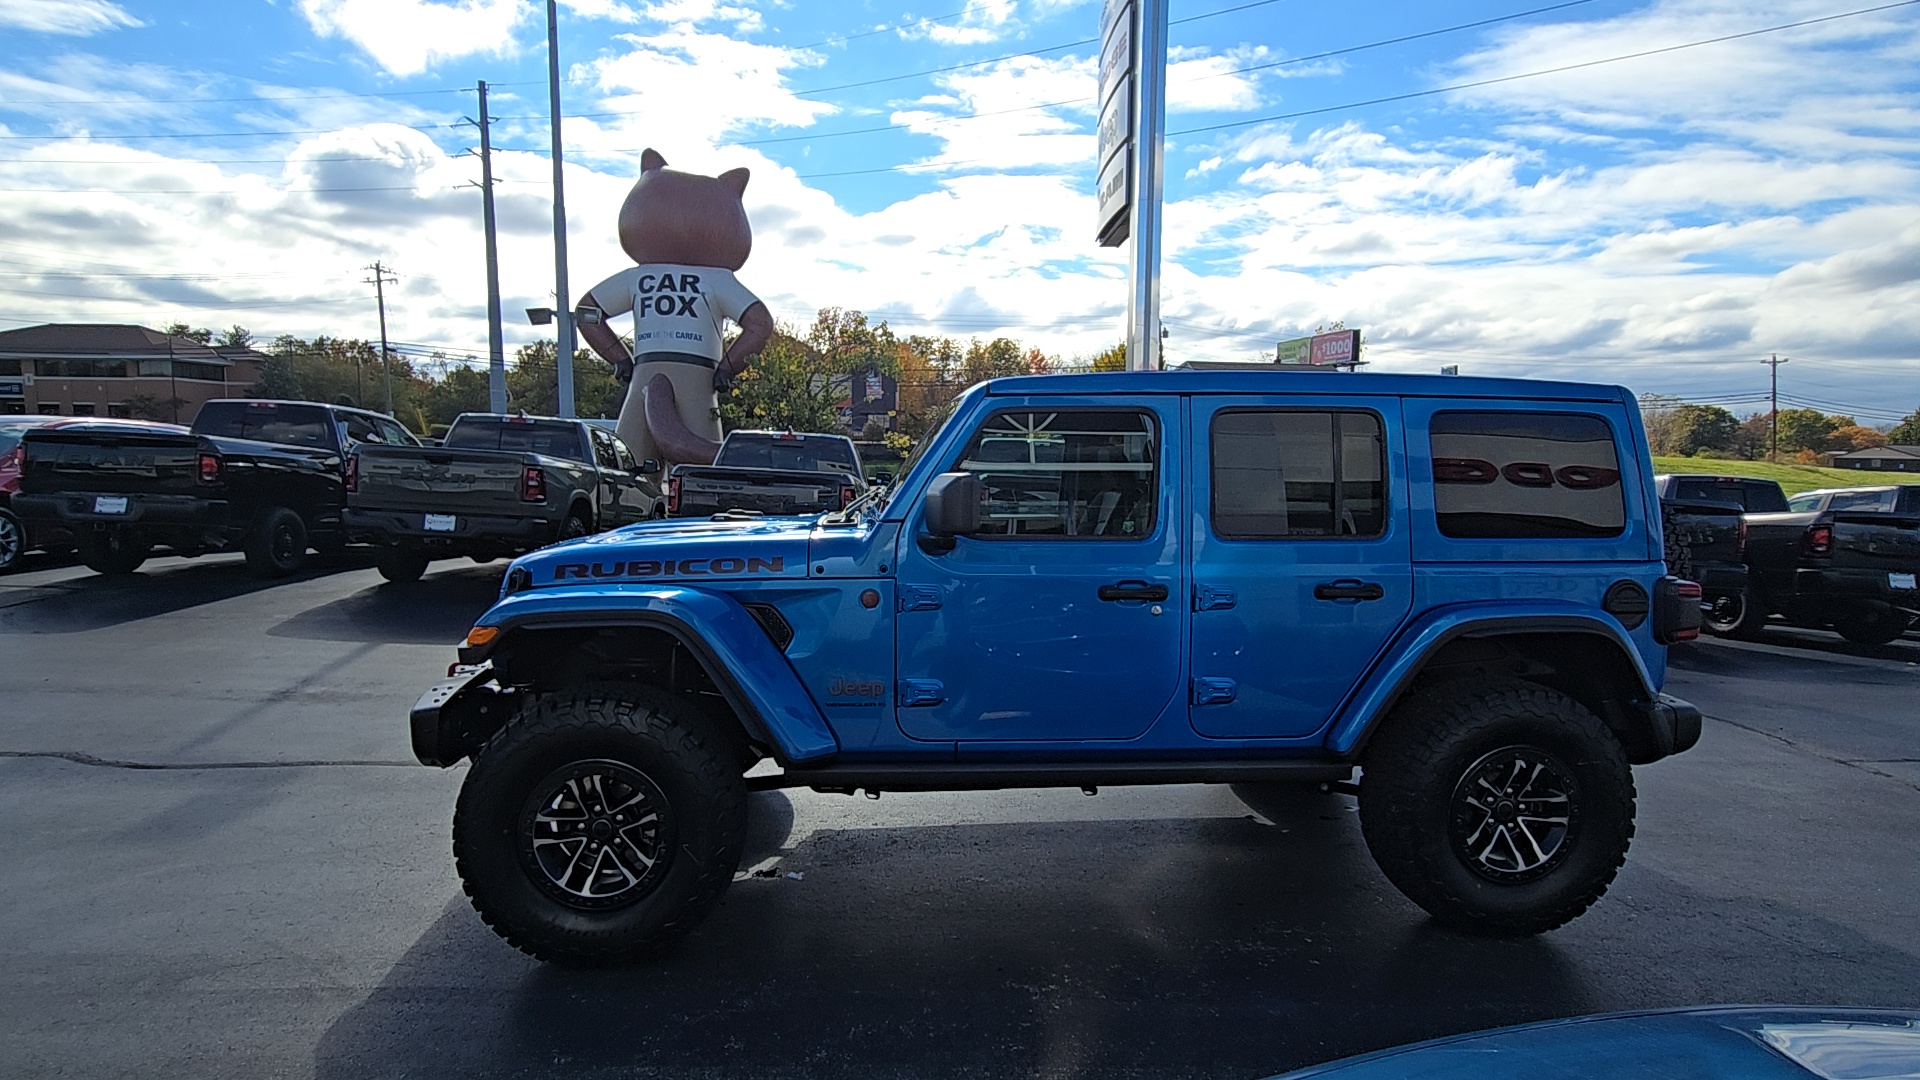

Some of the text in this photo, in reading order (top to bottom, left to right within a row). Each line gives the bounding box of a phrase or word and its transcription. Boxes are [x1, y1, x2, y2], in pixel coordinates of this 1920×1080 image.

[1100, 168, 1123, 211] RAM
[638, 273, 701, 294] CAR
[640, 295, 699, 318] FOX
[675, 331, 703, 342] CARFAX
[1322, 339, 1350, 356] $1000
[554, 556, 784, 580] RUBICON
[828, 676, 884, 699] Jeep
